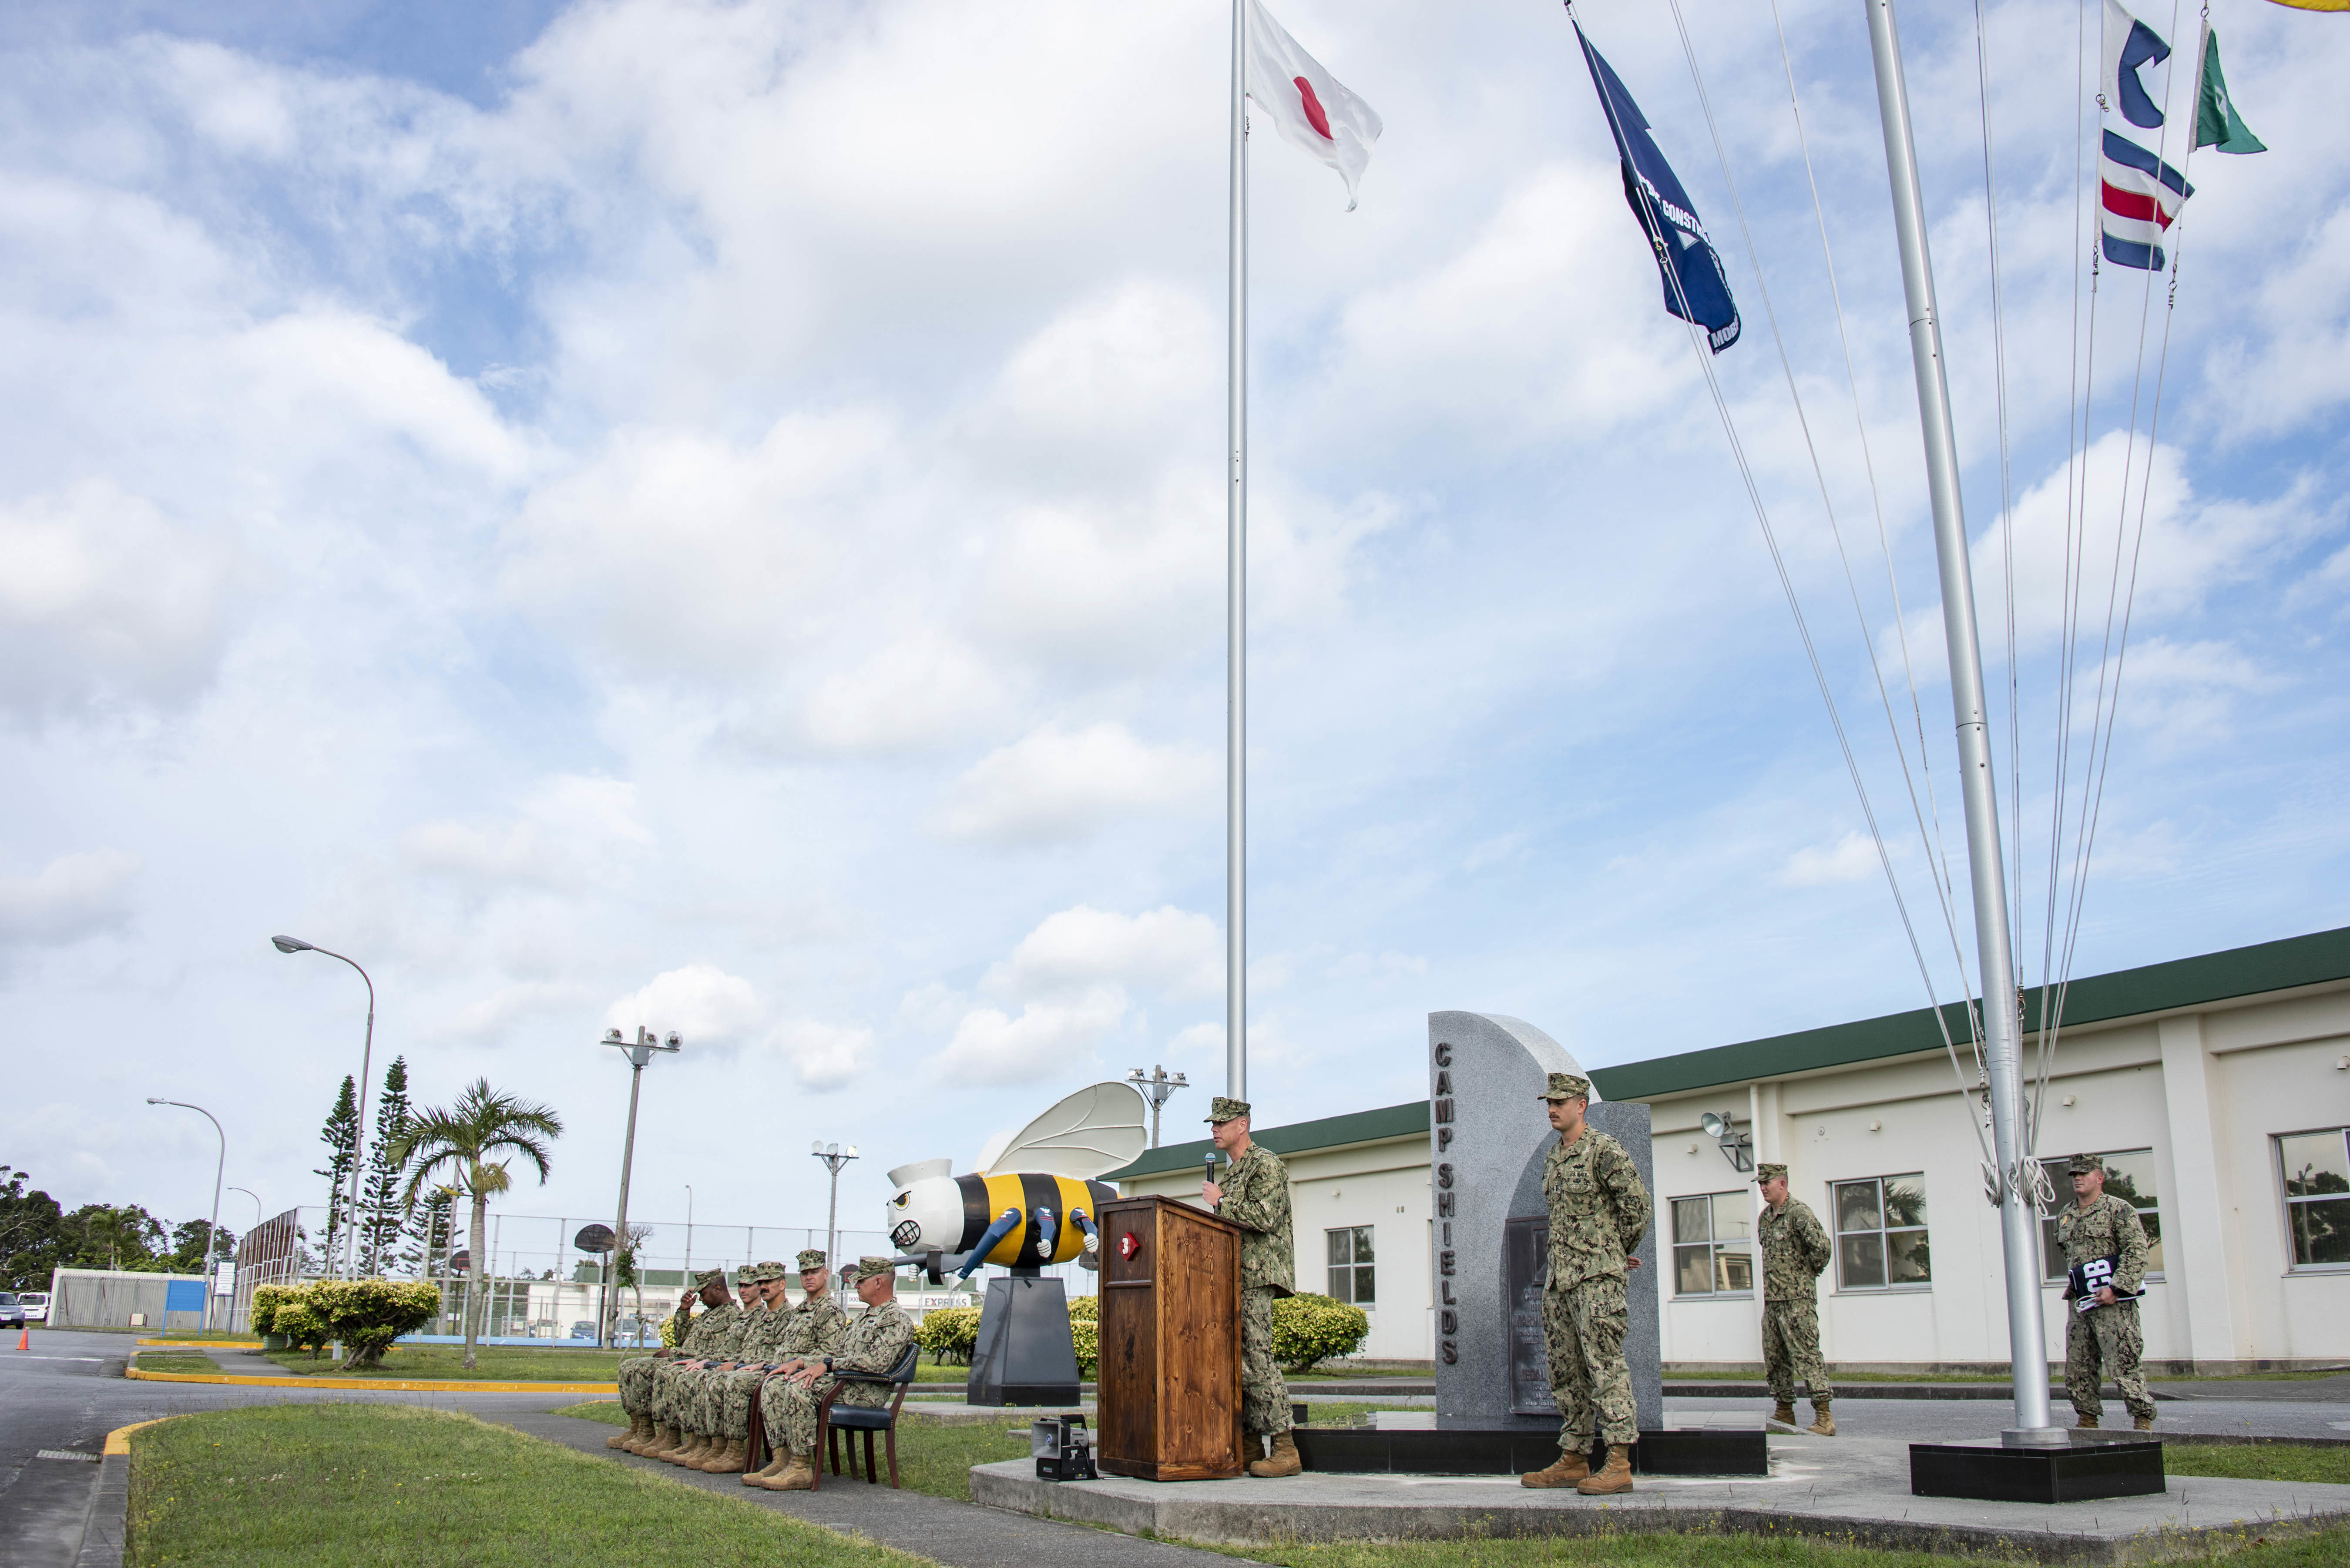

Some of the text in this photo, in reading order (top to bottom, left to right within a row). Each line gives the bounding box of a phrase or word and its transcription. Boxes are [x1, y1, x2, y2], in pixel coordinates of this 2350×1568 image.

[1435, 1042, 1458, 1365] CAMP SHIELDS
[1122, 1238, 1128, 1254] 3
[2083, 1259, 2112, 1293] CB
